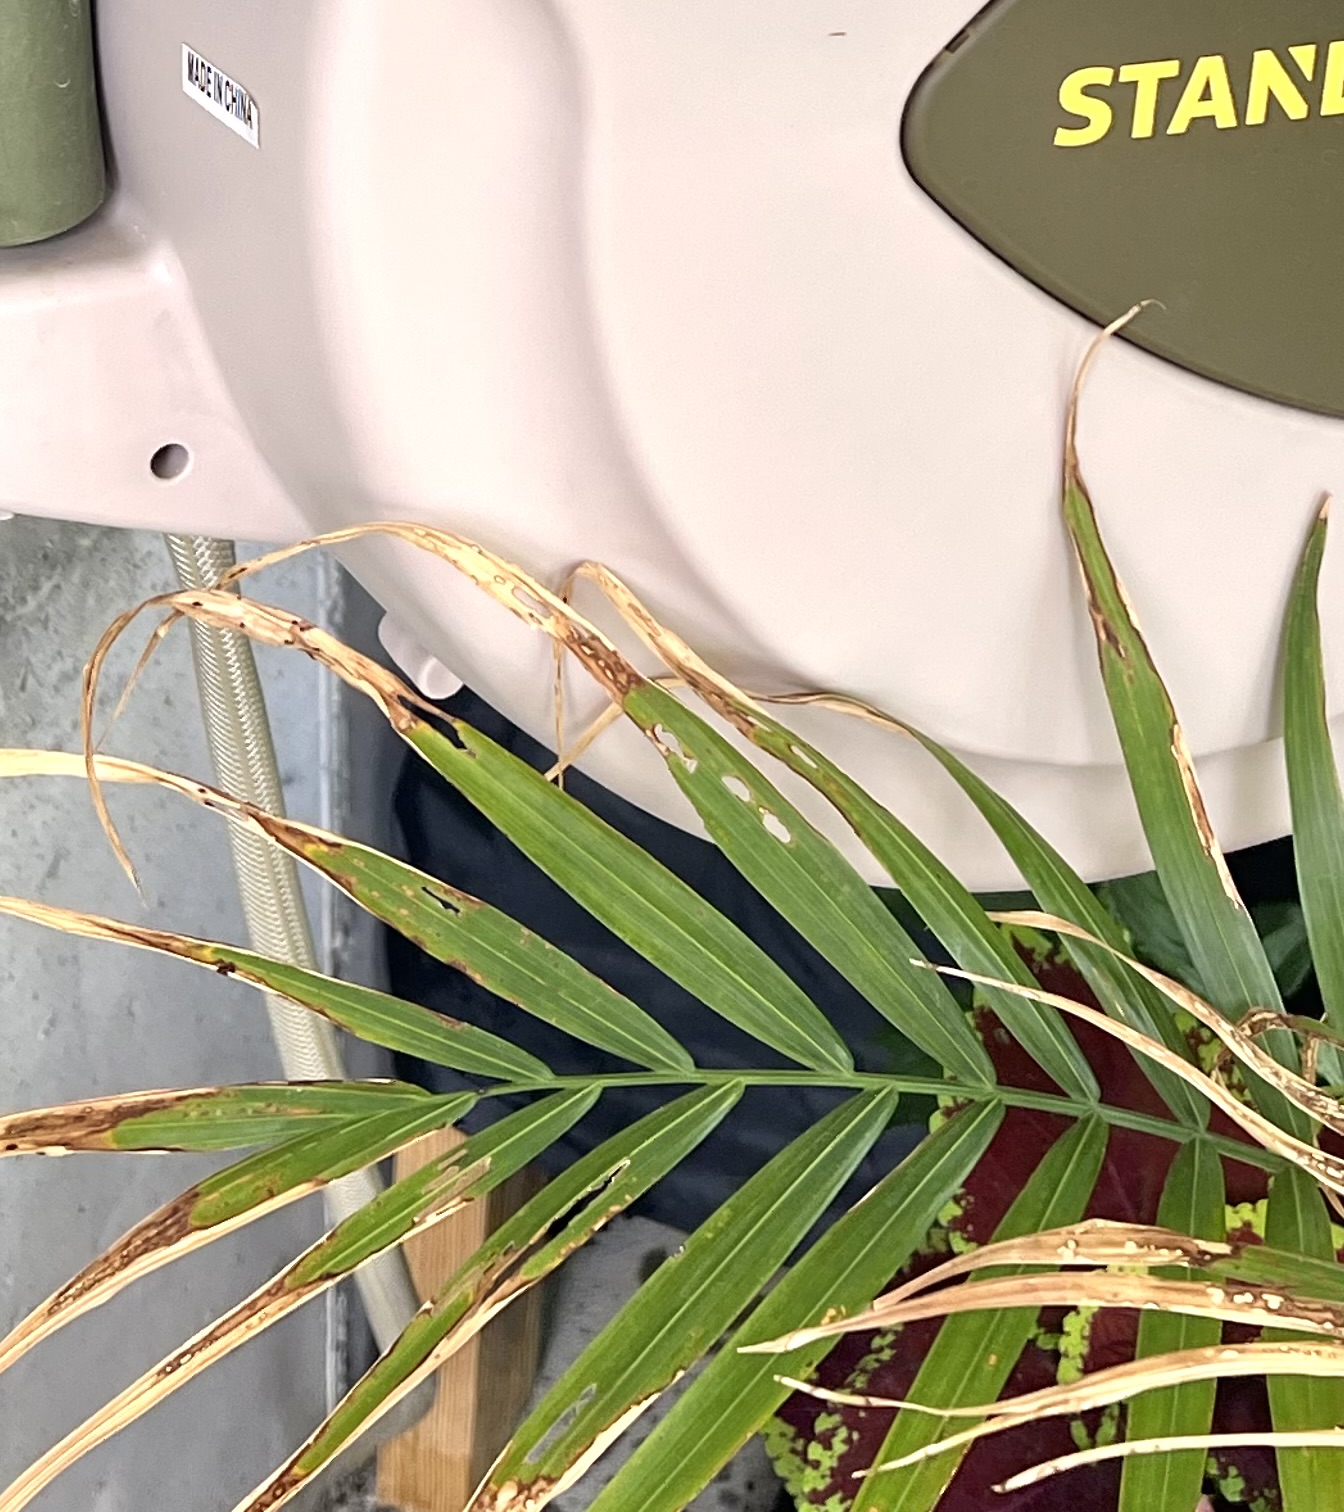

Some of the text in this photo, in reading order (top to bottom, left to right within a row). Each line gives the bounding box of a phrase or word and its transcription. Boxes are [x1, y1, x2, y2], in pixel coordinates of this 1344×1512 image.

[187, 50, 254, 130] MADE IN CHINA
